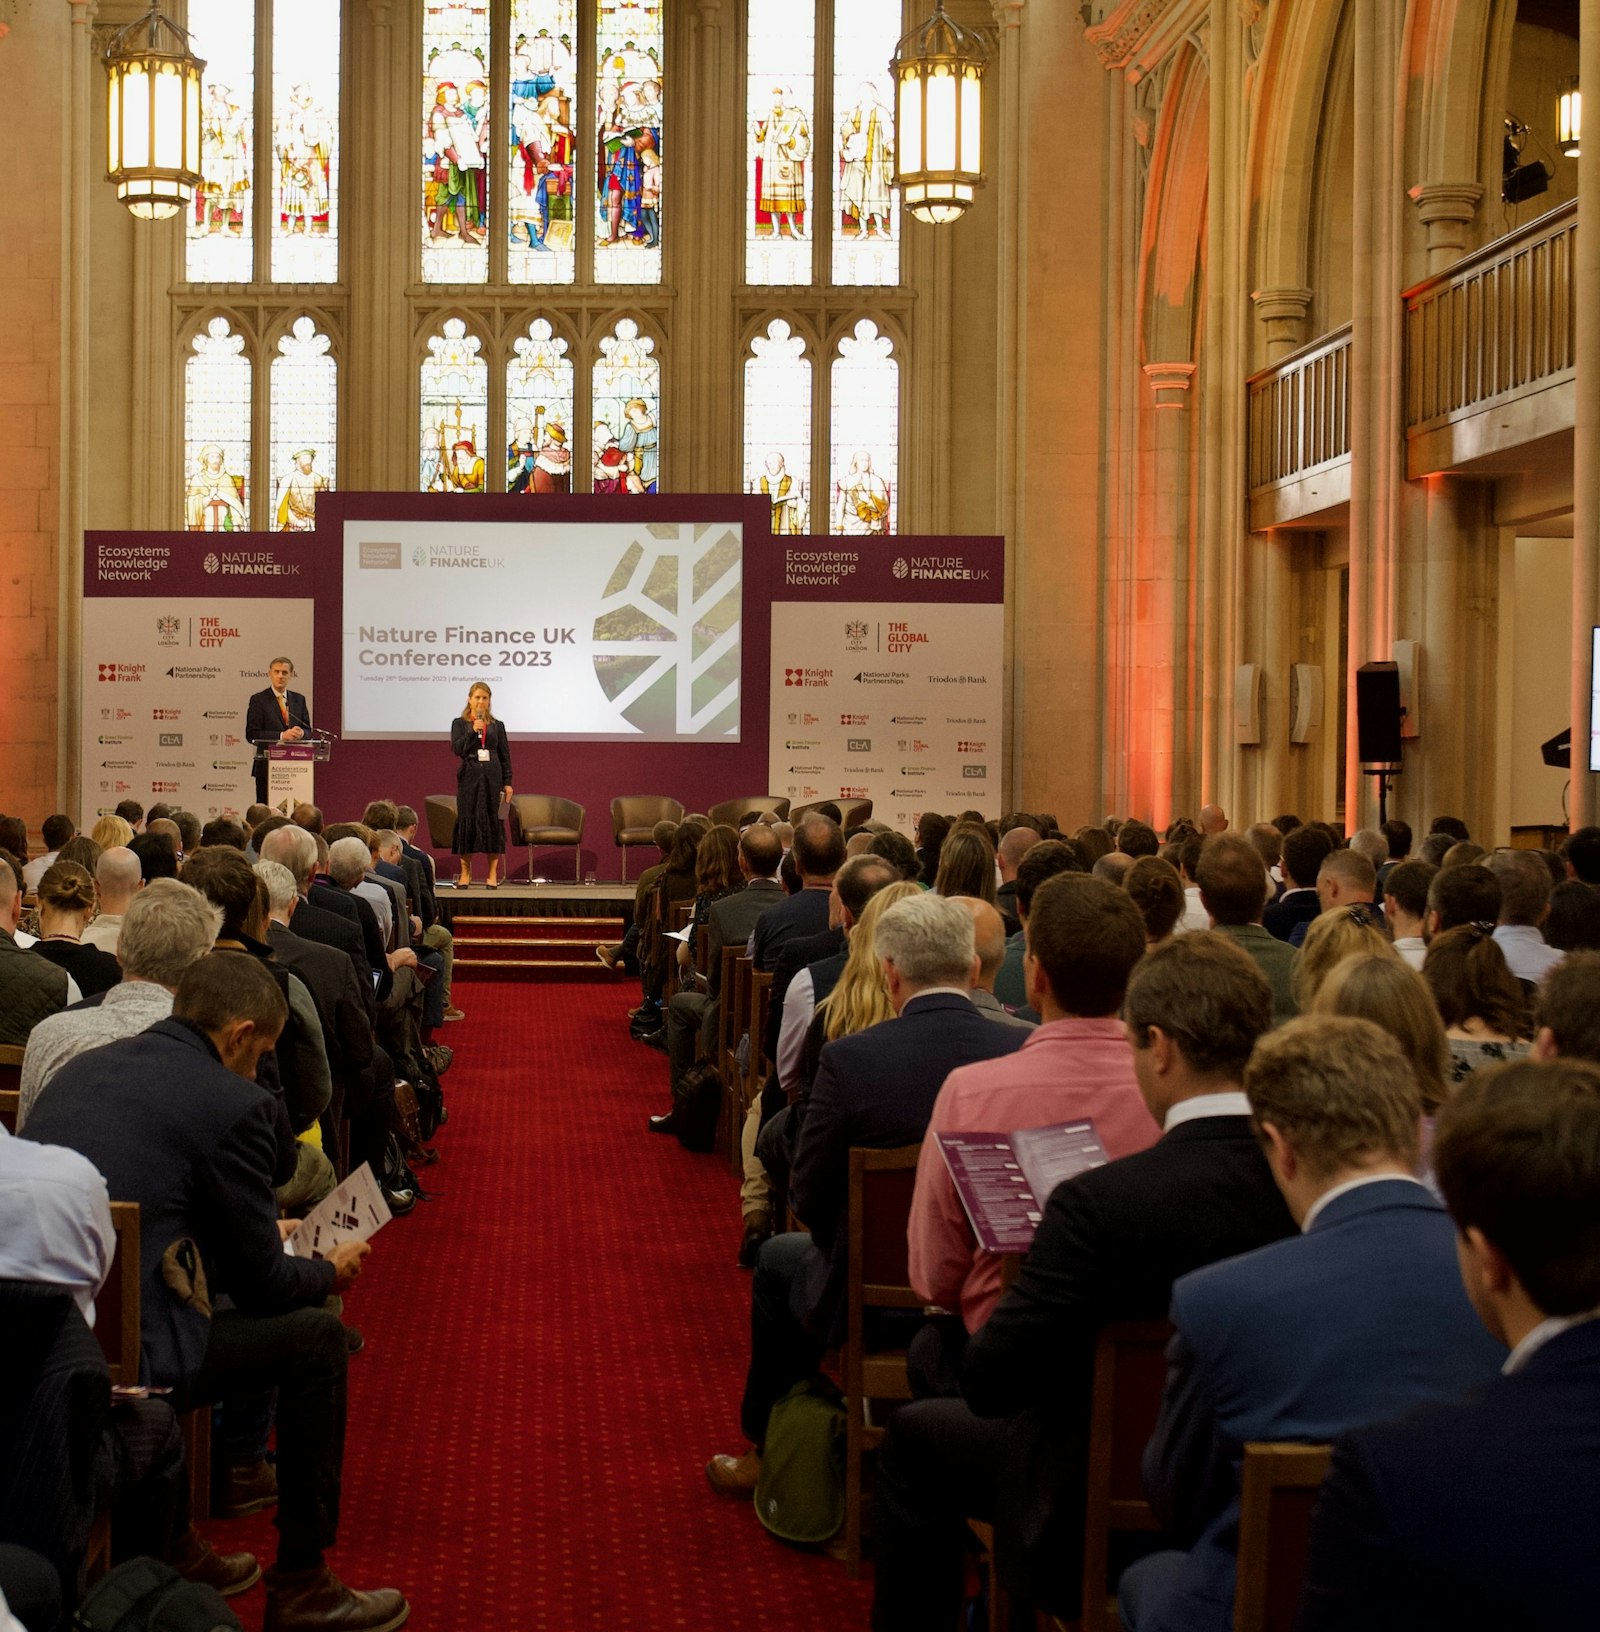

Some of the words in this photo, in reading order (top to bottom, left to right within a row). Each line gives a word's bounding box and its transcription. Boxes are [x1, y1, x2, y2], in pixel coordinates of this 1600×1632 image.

[98, 546, 170, 558] Ecosystems
[430, 546, 479, 556] NATURE
[222, 553, 274, 563] NATURE
[786, 550, 859, 563] Ecosystems
[98, 558, 168, 571] Knowledge
[911, 557, 963, 568] NATURE
[786, 562, 856, 575] Knowledge
[98, 570, 151, 580] Network
[786, 574, 839, 585] Network
[200, 618, 219, 626] THE
[200, 628, 240, 637] GLOBAL
[888, 623, 908, 632] THE
[359, 626, 437, 643] Nature
[446, 626, 536, 643] Finance
[544, 628, 576, 644] UK
[888, 633, 929, 642] GLOBAL
[200, 639, 224, 647] CITY
[888, 644, 912, 653] CITY
[359, 649, 492, 667] Conference
[499, 650, 552, 667] 2023
[118, 664, 145, 673] Knight
[805, 669, 833, 678] Knight
[118, 674, 141, 682] Frank
[805, 679, 828, 687] Frank
